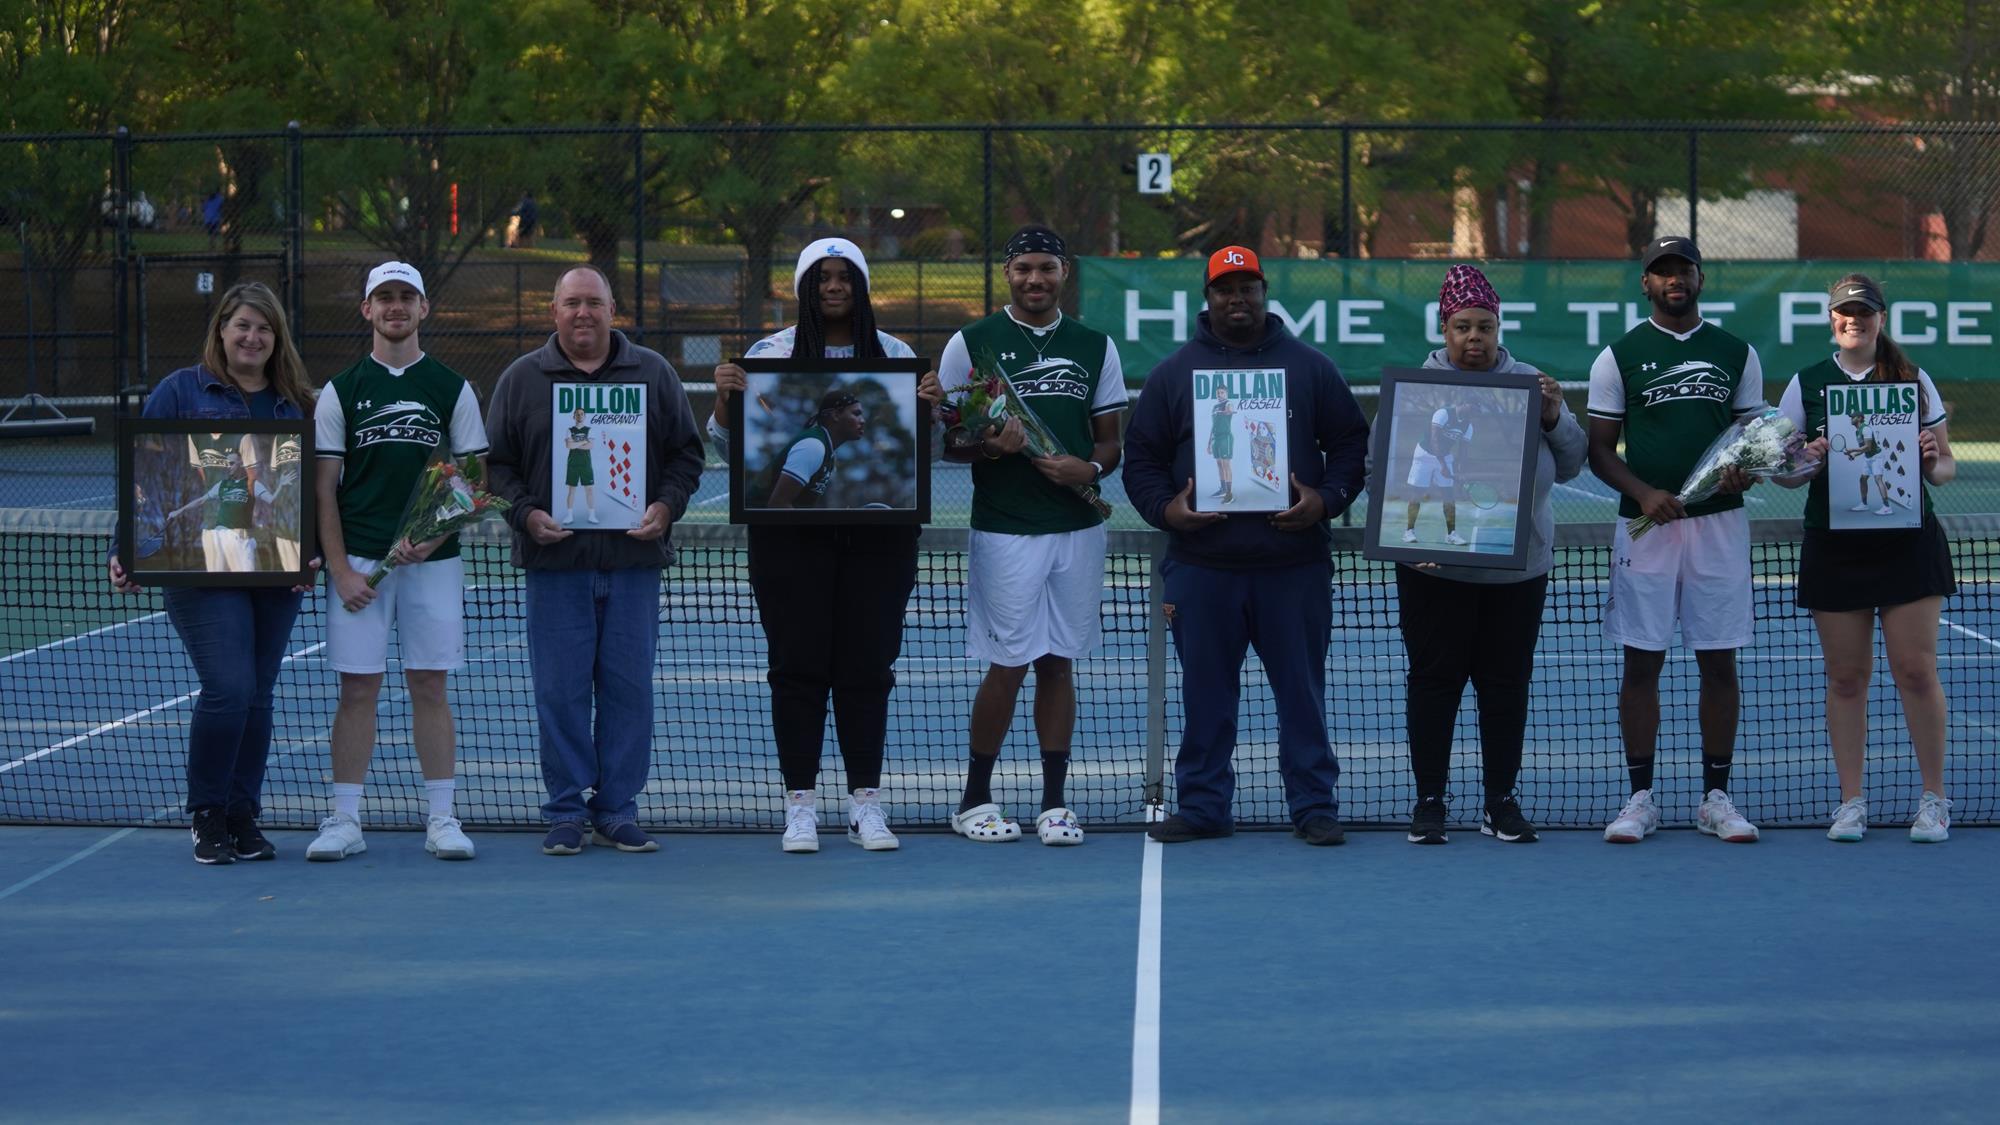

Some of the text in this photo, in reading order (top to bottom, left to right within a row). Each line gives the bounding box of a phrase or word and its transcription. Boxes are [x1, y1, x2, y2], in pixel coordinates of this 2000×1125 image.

[1149, 157, 1162, 189] 2
[1223, 251, 1245, 266] JC
[1125, 289, 1385, 343] HME
[1779, 291, 1993, 345] PCE
[1195, 373, 1284, 400] DALLAN
[1642, 382, 1730, 406] PACERS
[558, 387, 641, 414] DILLON
[1237, 398, 1283, 410] RUSSELL
[1829, 386, 1916, 416] DALLAS
[590, 413, 643, 425] GARBRANDT
[1868, 413, 1913, 426] RUSSELL
[355, 424, 441, 448] PACERS
